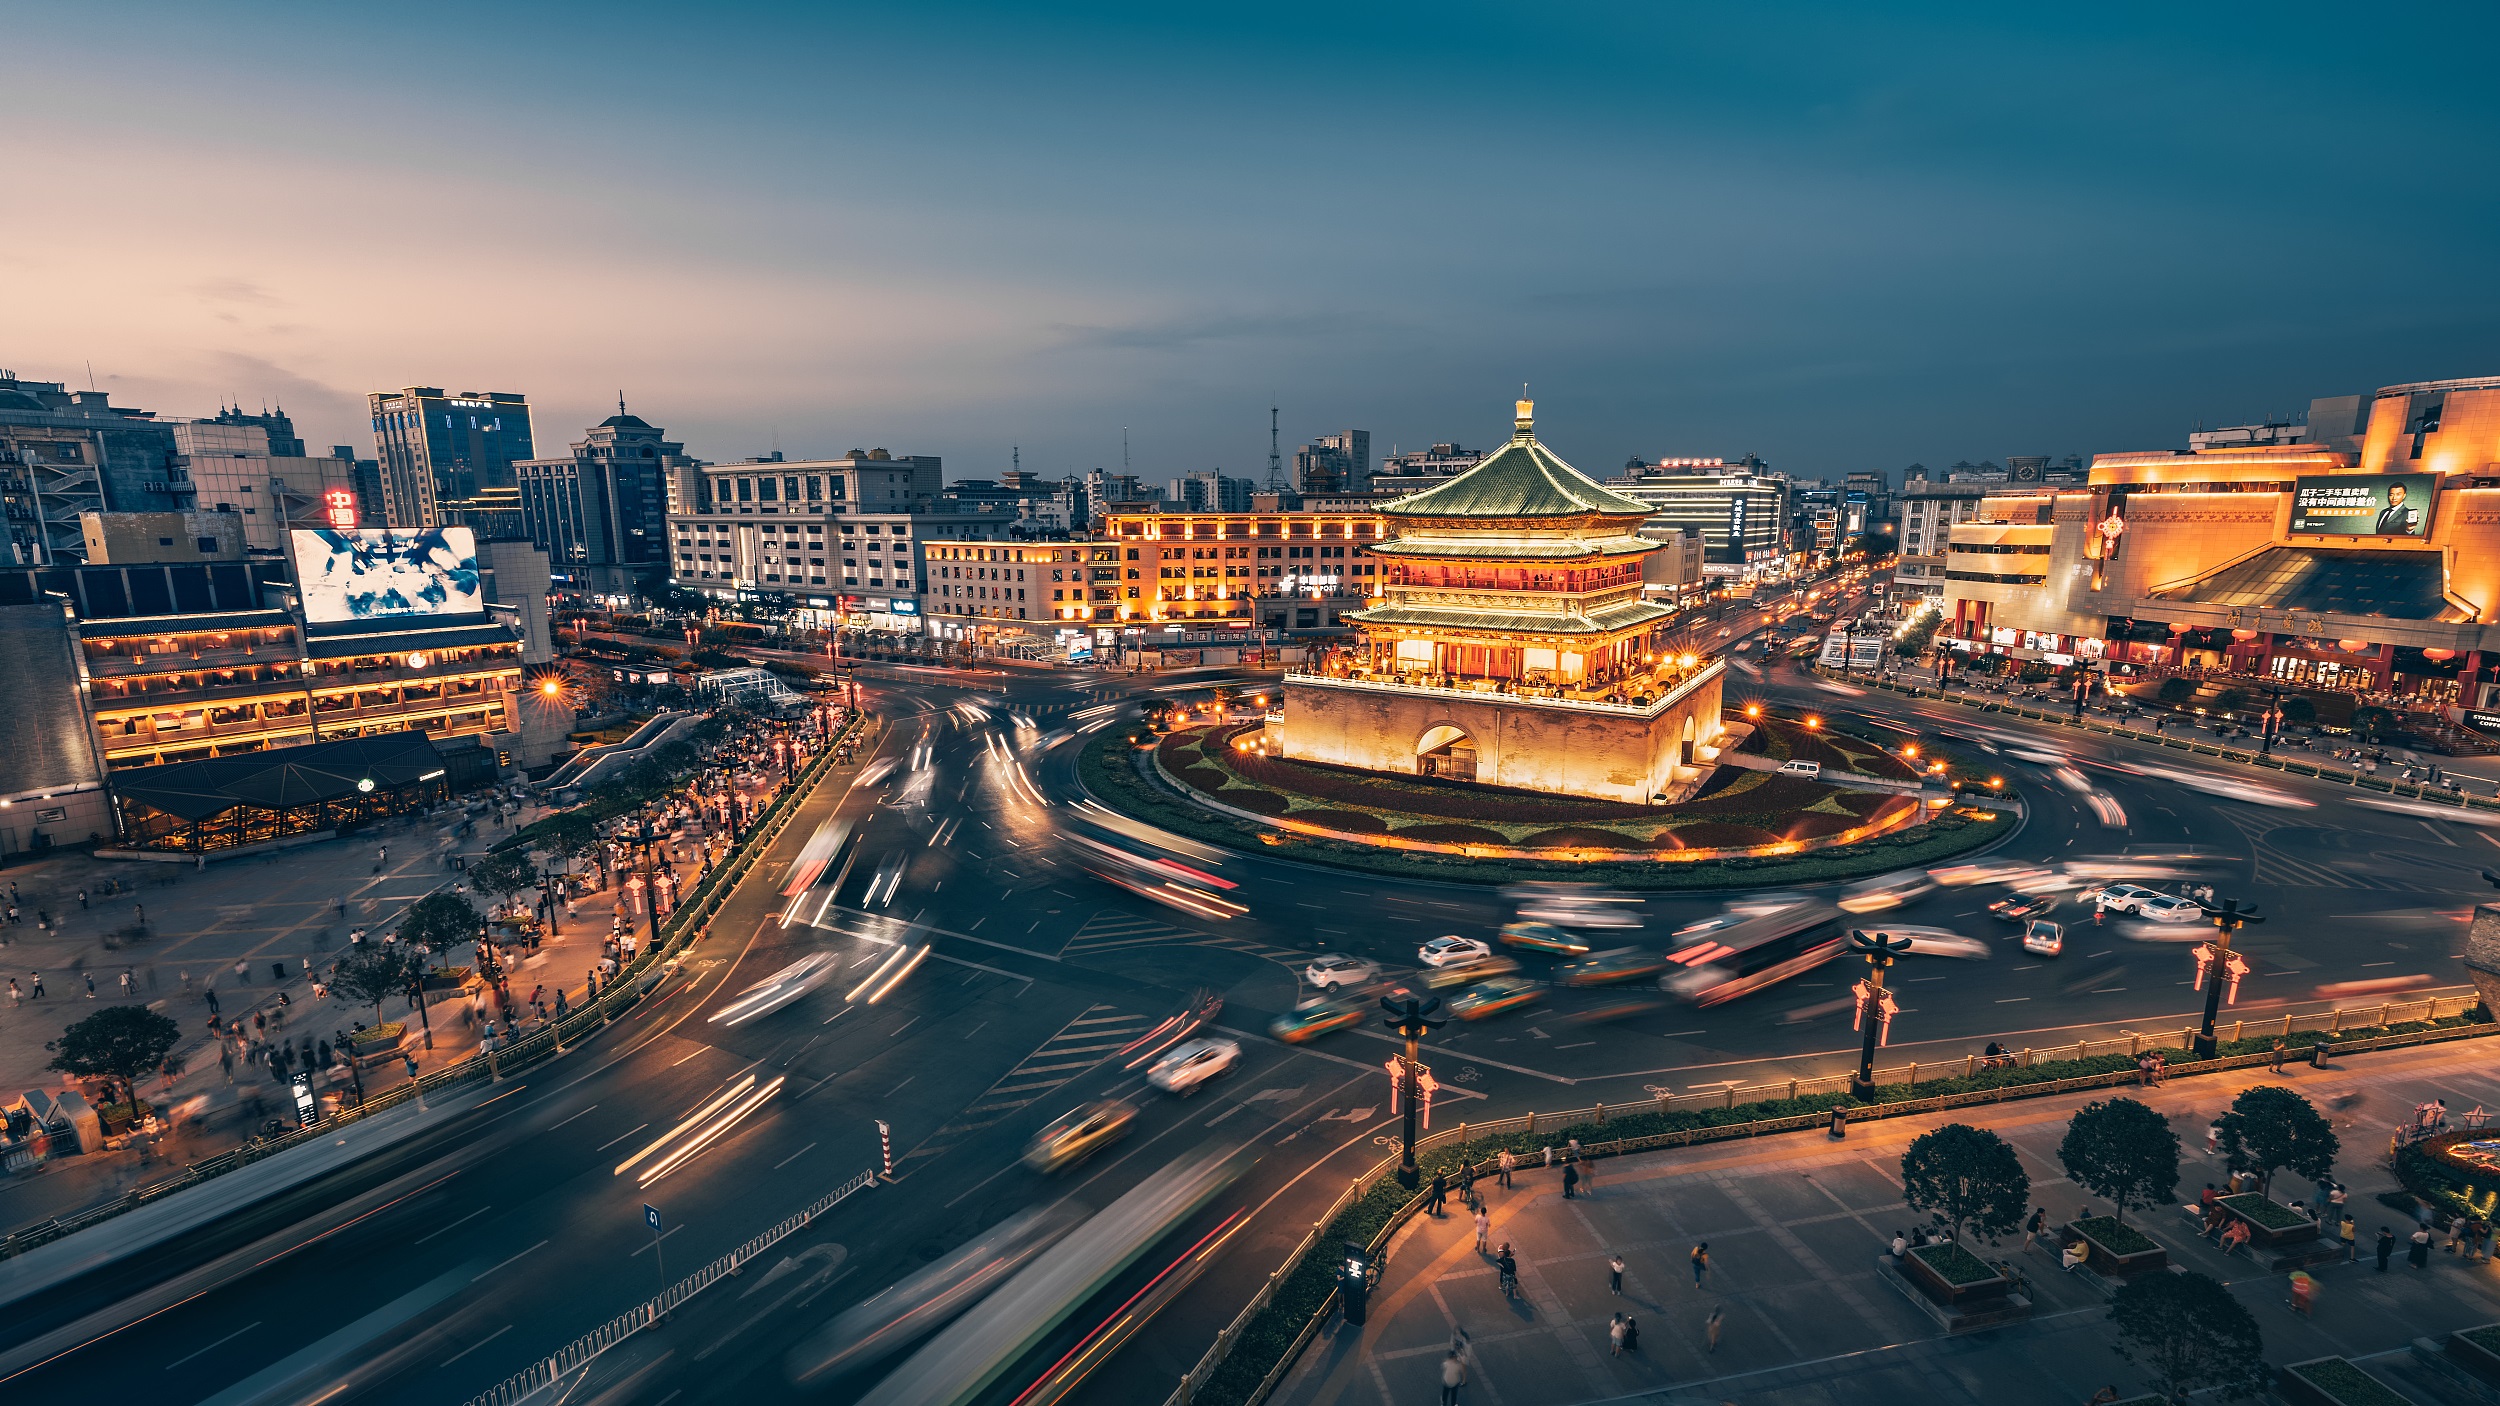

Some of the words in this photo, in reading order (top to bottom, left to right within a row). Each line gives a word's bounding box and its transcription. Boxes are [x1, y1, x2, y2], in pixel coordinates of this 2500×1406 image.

[2300, 488, 2370, 497] 瓜子二手车直卖网
[2298, 496, 2377, 507] 没有中间商赚差价
[326, 491, 355, 529] 中国
[893, 600, 914, 612] vivo
